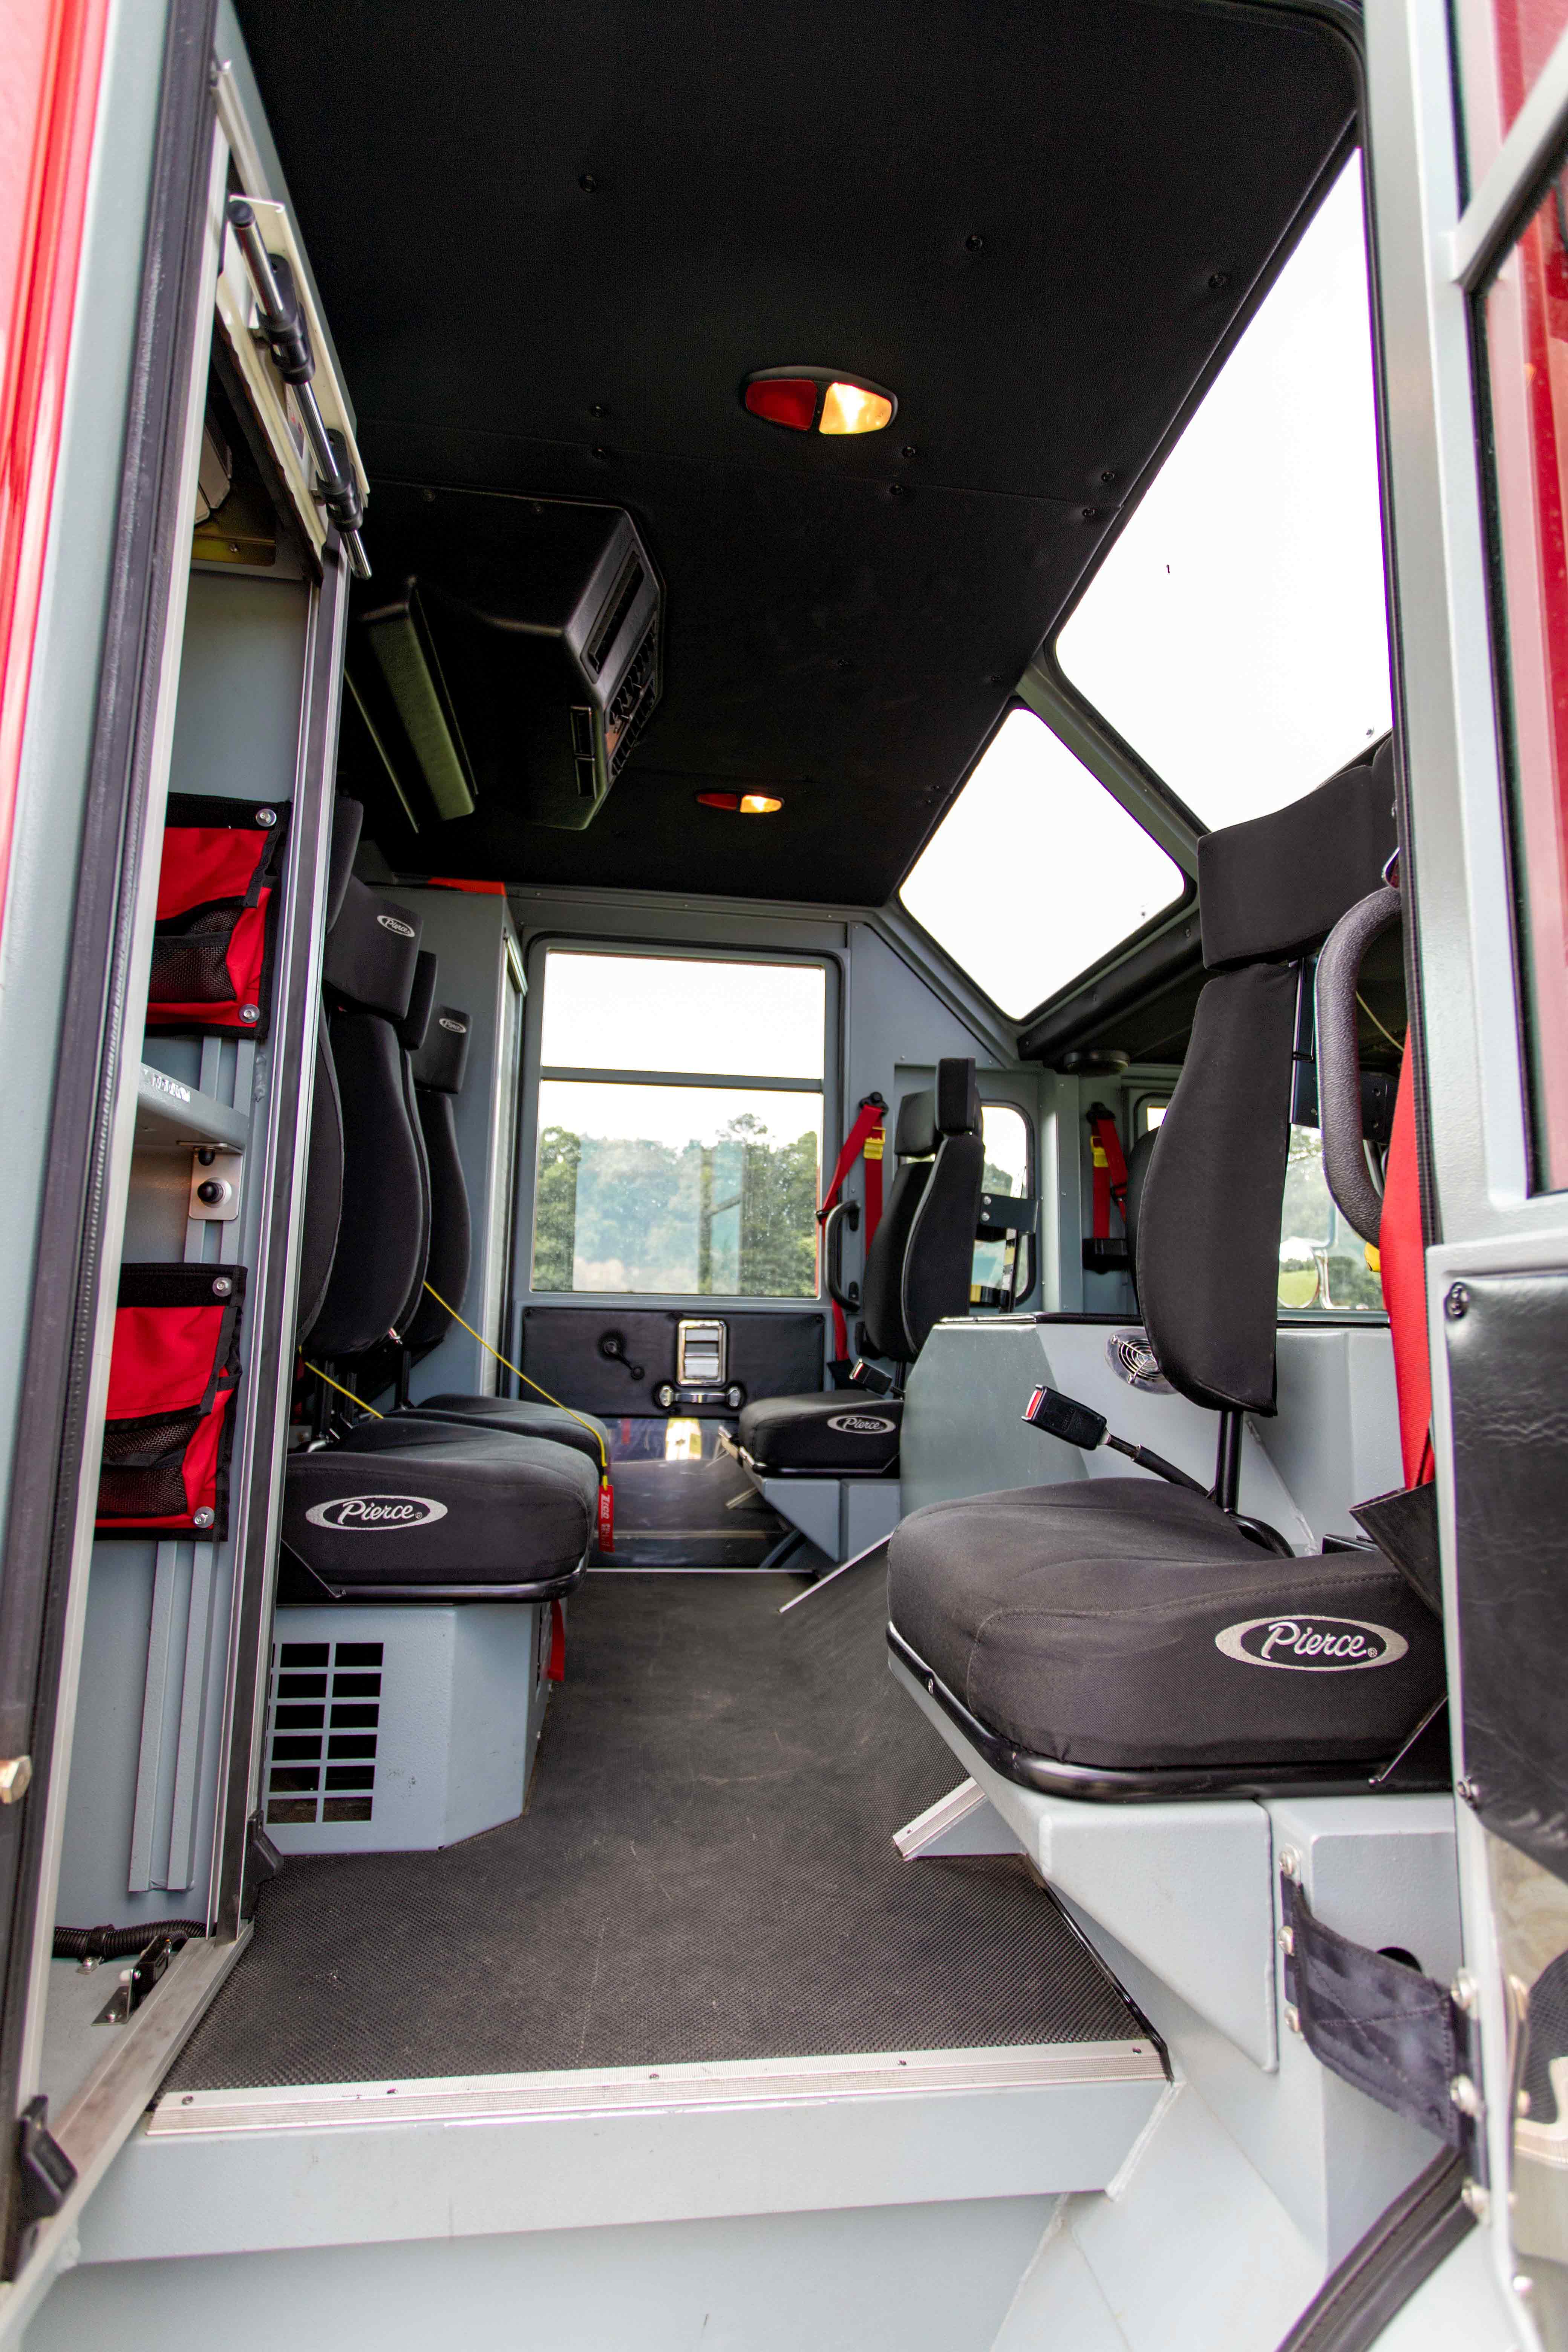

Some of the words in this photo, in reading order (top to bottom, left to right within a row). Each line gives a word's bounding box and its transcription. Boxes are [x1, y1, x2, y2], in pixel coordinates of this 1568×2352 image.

[387, 919, 408, 933] Pierce
[843, 1417, 880, 1430] Pierce
[338, 1501, 414, 1524] Pierce
[1262, 1621, 1367, 1659] Pierce
